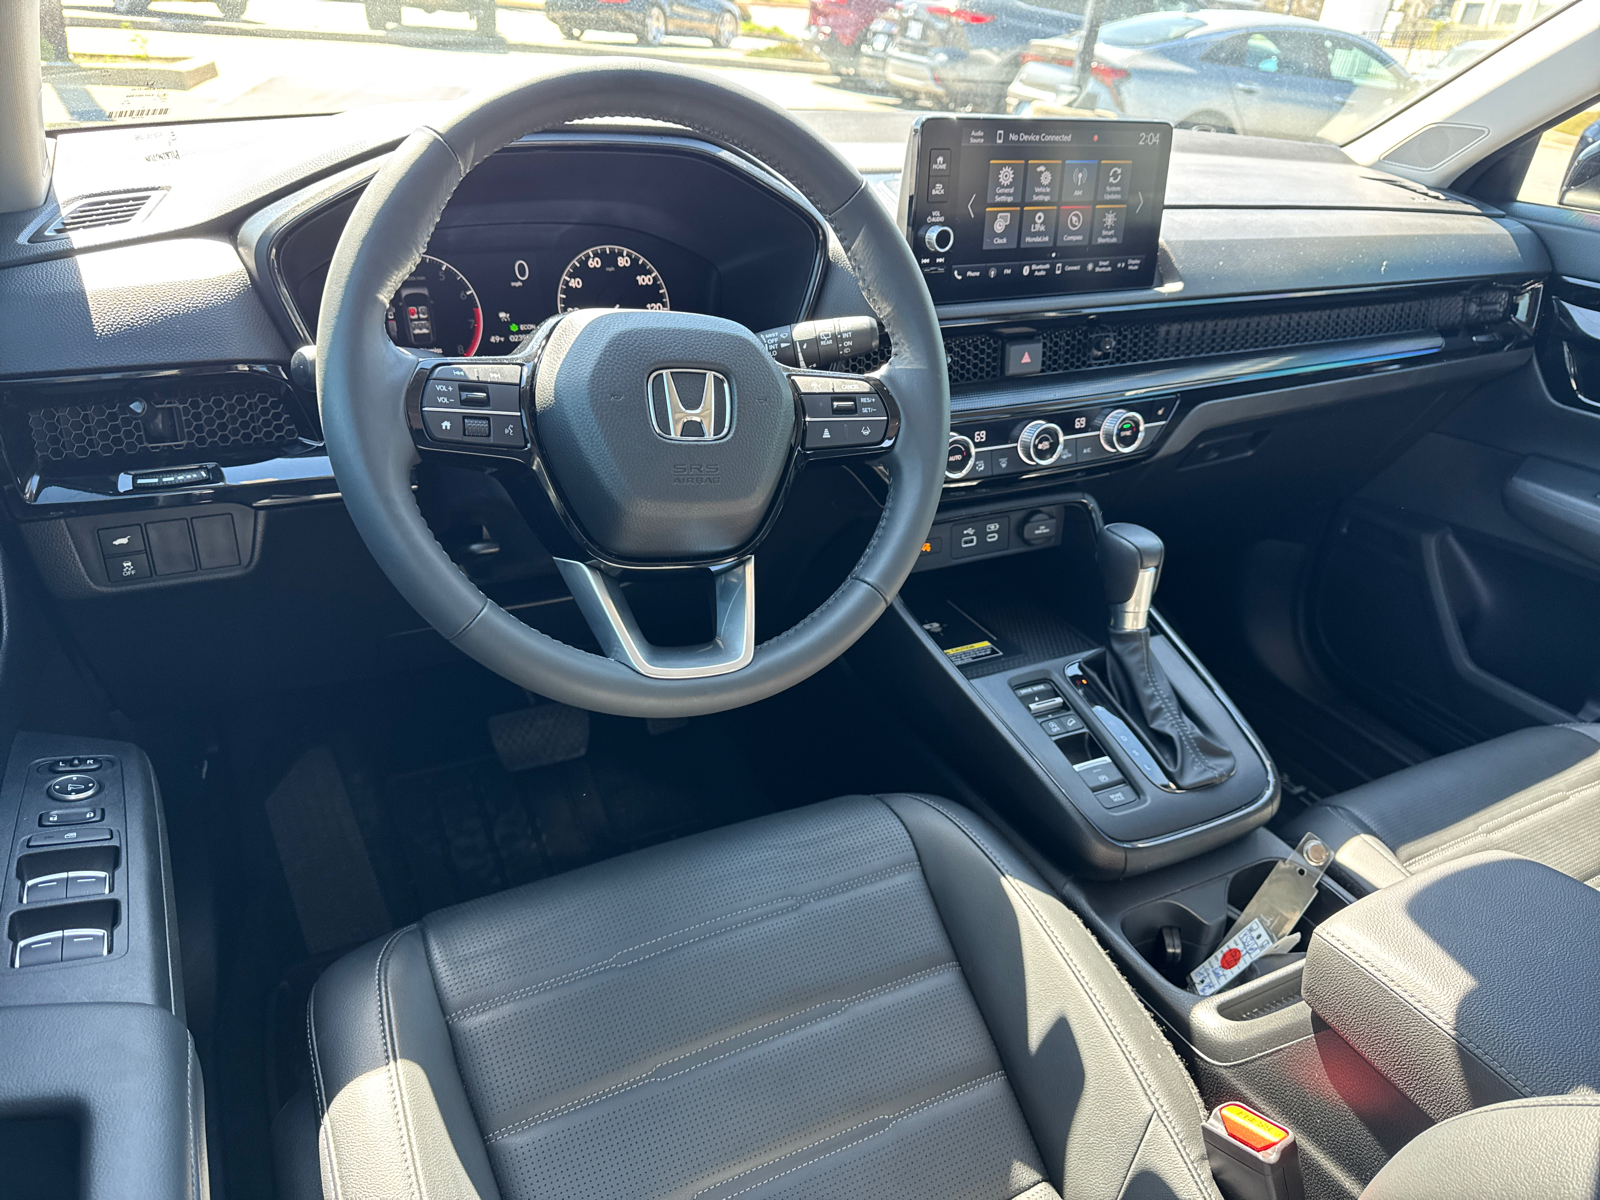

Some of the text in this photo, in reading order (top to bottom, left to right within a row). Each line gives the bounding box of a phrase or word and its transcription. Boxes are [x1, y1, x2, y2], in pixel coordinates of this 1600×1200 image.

[1008, 132, 1072, 142] No Device Connected
[1138, 132, 1160, 145] 2:04
[994, 194, 1014, 202] Settings
[1032, 194, 1051, 202] Settings
[993, 236, 1008, 244] Clock
[588, 257, 602, 268] 60
[617, 256, 631, 268] 80
[514, 260, 530, 280] 0
[438, 271, 446, 281] 5
[636, 274, 654, 286] 100
[568, 278, 582, 288] 40
[460, 290, 467, 300] 6
[468, 320, 474, 329] 7
[458, 345, 464, 354] 8
[1074, 417, 1086, 429] 69
[974, 430, 986, 442] 69
[673, 464, 720, 474] SRS
[673, 476, 721, 485] AIRBAG
